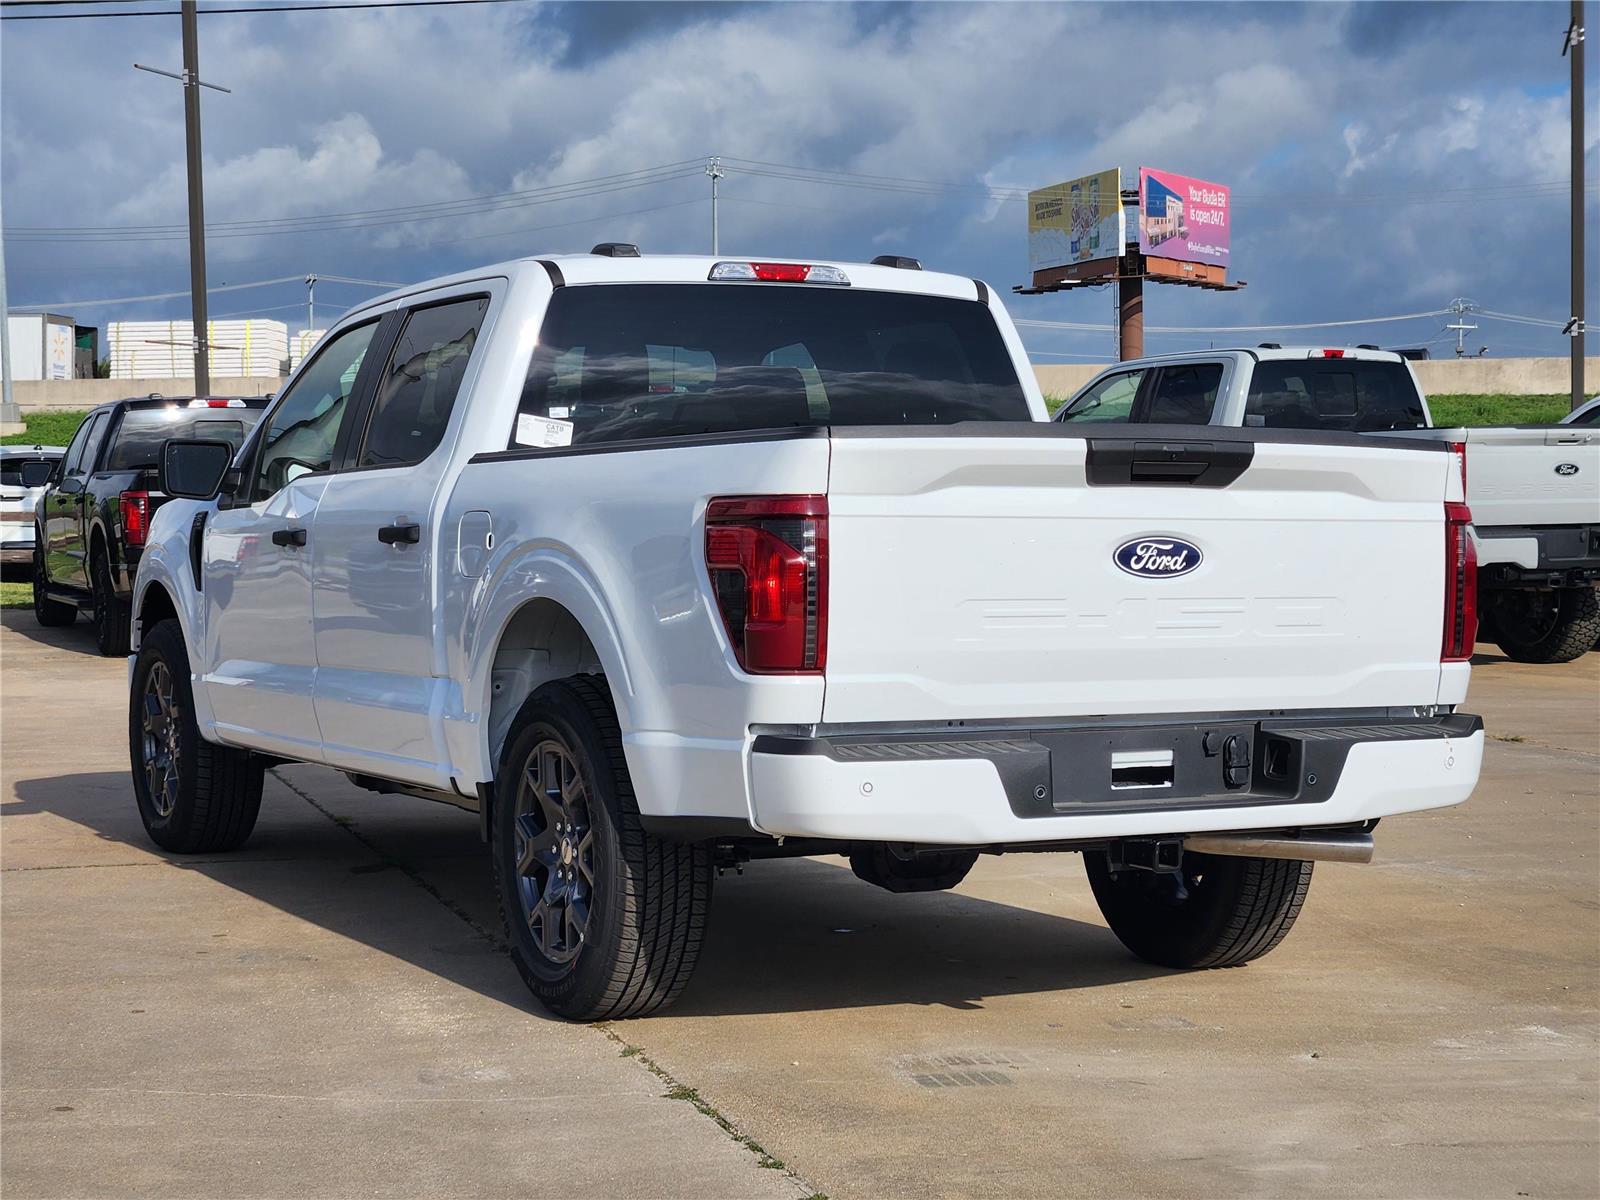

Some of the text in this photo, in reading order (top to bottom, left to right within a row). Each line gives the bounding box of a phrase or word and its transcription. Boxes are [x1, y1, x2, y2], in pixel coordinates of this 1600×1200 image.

[1188, 185, 1226, 208] Your Buda ER
[1190, 205, 1196, 220] is
[1195, 209, 1211, 225] open
[1560, 464, 1575, 474] Ford
[1130, 542, 1188, 570] Ford
[953, 596, 1346, 642] F-150
